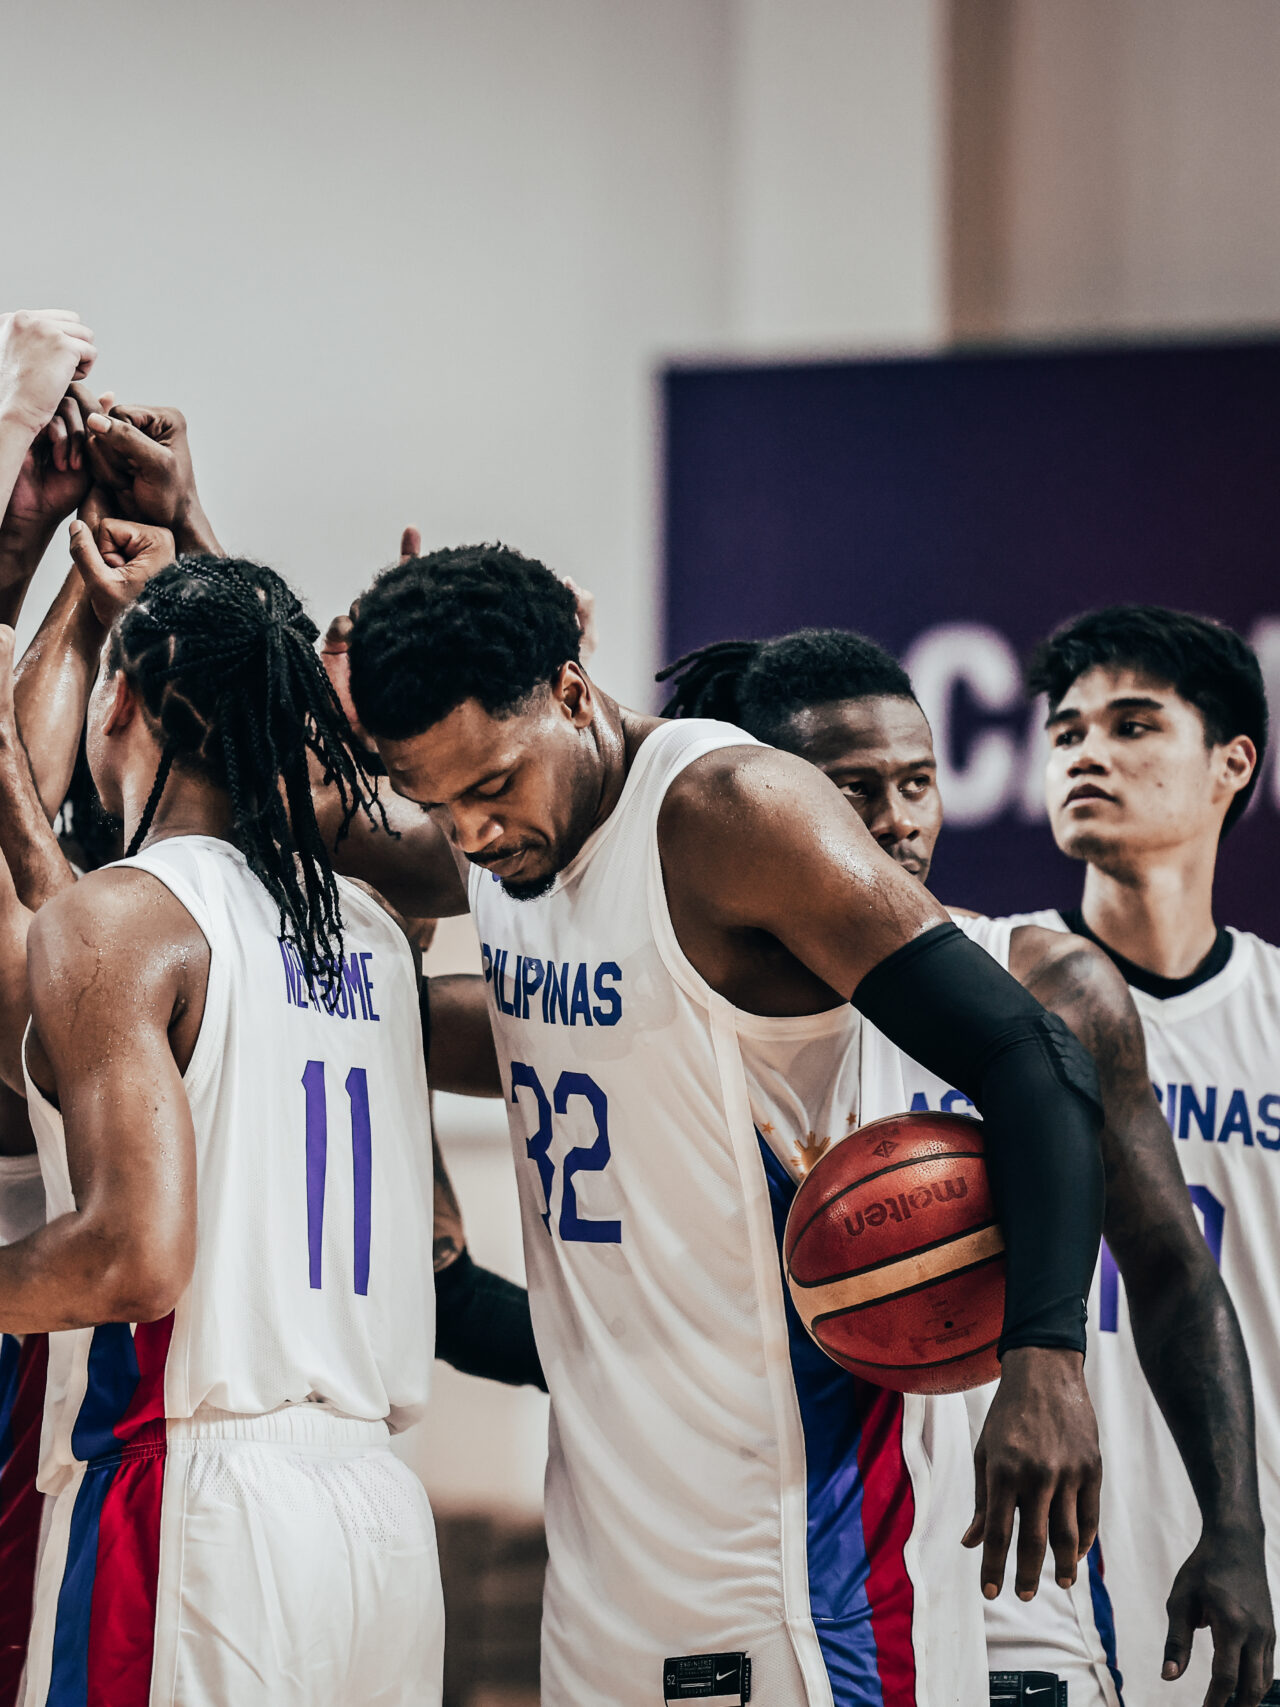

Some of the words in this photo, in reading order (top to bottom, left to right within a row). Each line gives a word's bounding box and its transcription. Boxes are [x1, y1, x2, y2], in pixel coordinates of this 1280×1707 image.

[1151, 1082, 1280, 1152] INAS
[301, 1060, 372, 1296] 11
[844, 1176, 968, 1237] molten
